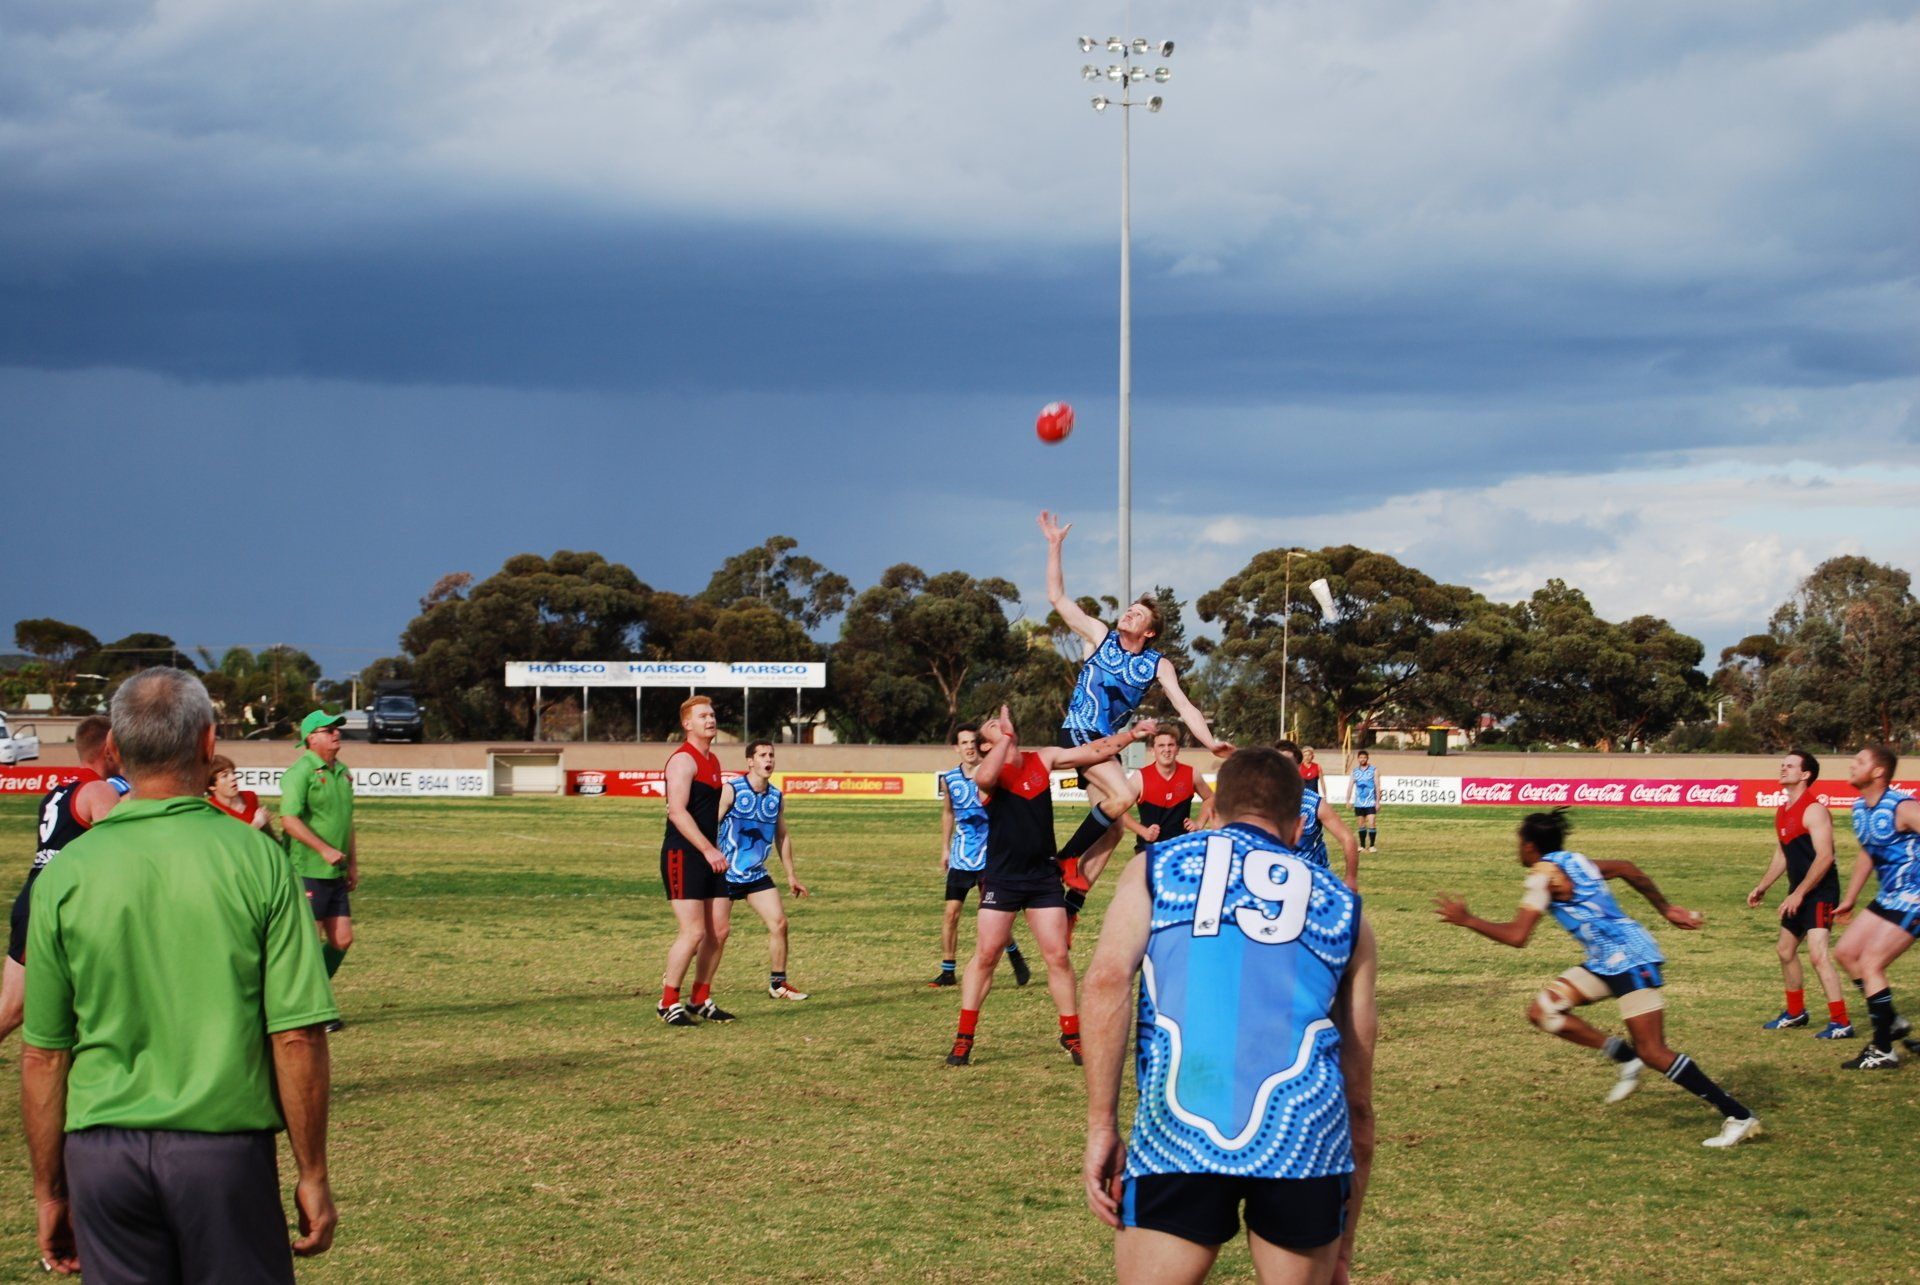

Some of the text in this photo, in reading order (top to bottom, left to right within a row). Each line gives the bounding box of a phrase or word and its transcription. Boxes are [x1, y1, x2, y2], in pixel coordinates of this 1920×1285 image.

[528, 664, 605, 673] HARSCO
[629, 664, 706, 673] HARSCO
[731, 665, 807, 674] HARSCO
[46, 774, 60, 790] &
[356, 772, 412, 786] LOWE
[419, 776, 483, 790] 8644 1959
[619, 772, 645, 780] BORN
[1397, 779, 1440, 787] PHONE
[840, 778, 882, 790] choice
[1380, 790, 1456, 803] 8645 8849
[1463, 783, 1515, 801] Coca-Cola
[1518, 783, 1570, 802] Coca-Cola
[1574, 784, 1627, 802] Coca-Cola
[1630, 784, 1683, 802] Coca-Cola
[1686, 785, 1739, 803] Coca-Cola
[1191, 834, 1313, 945] 19
